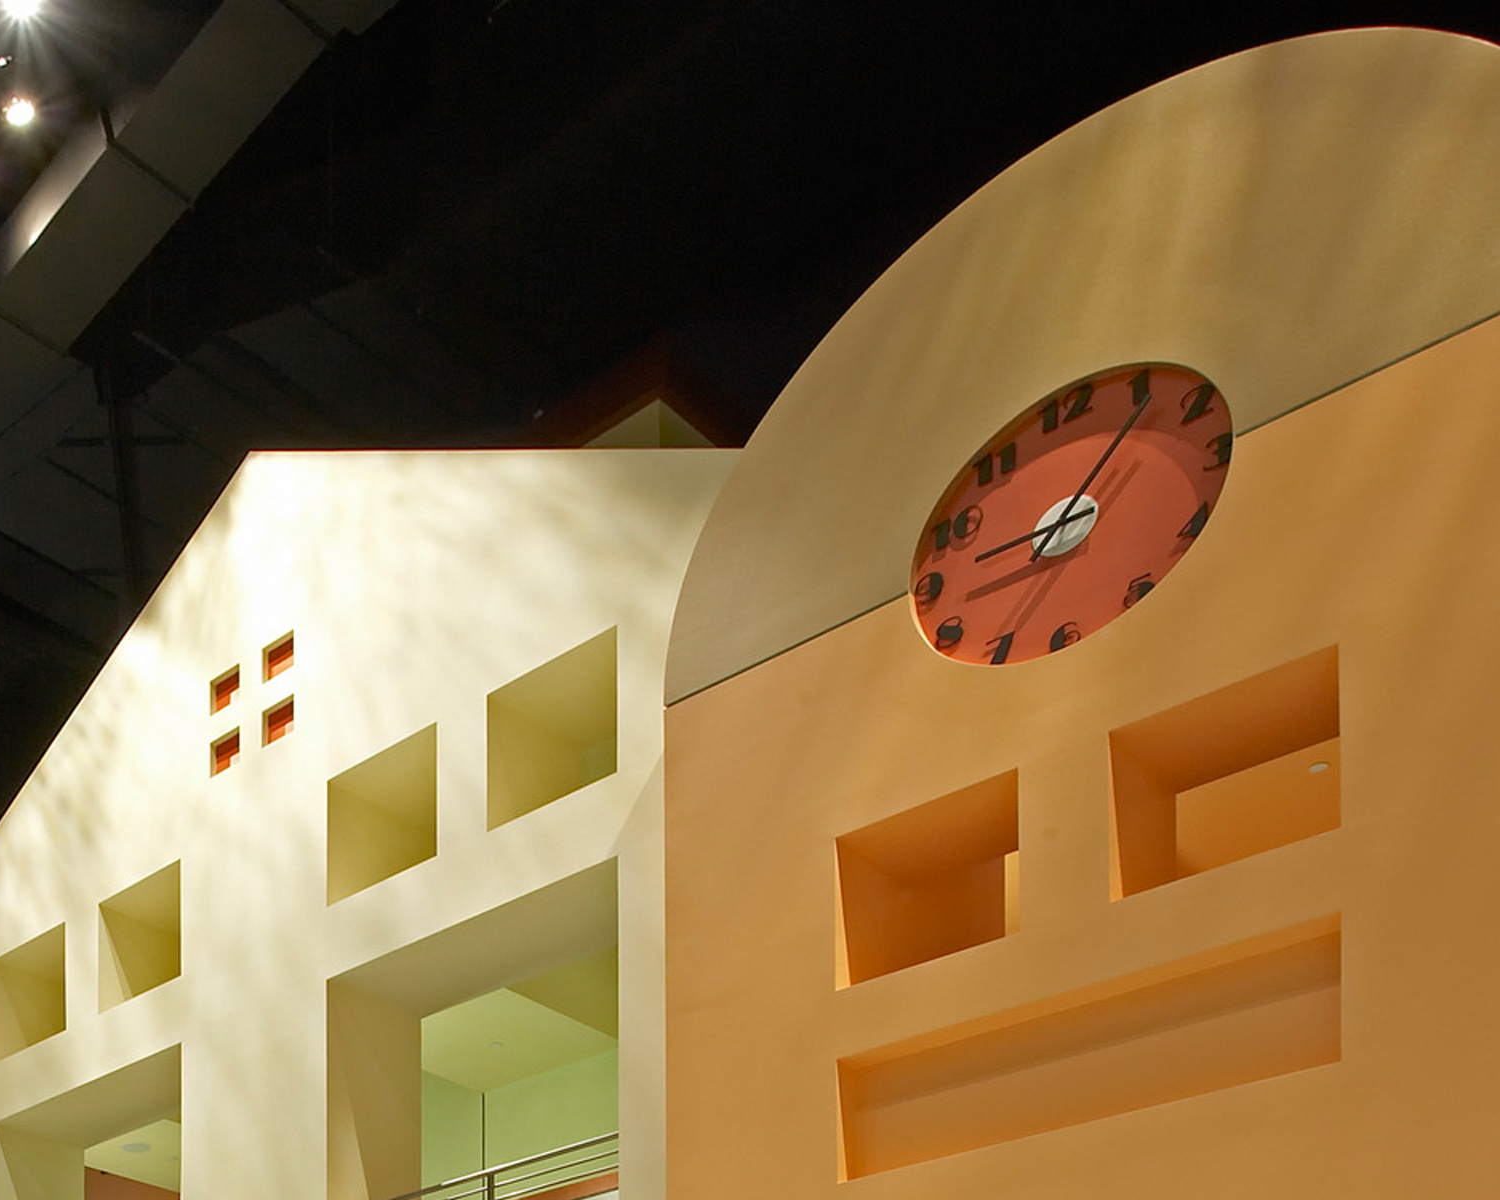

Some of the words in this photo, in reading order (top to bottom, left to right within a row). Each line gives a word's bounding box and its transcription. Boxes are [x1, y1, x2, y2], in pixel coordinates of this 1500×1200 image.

[1126, 370, 1150, 405] 1
[1180, 382, 1216, 426] 2
[1038, 382, 1095, 434] 12
[972, 442, 1017, 487] 11
[1203, 432, 1233, 471] 3
[931, 505, 984, 551] 10
[1176, 501, 1209, 538] 4
[915, 572, 944, 606] 9
[1123, 572, 1155, 609] 5
[936, 616, 964, 649] 8
[985, 630, 1016, 665] 7
[1049, 621, 1081, 654] 6
